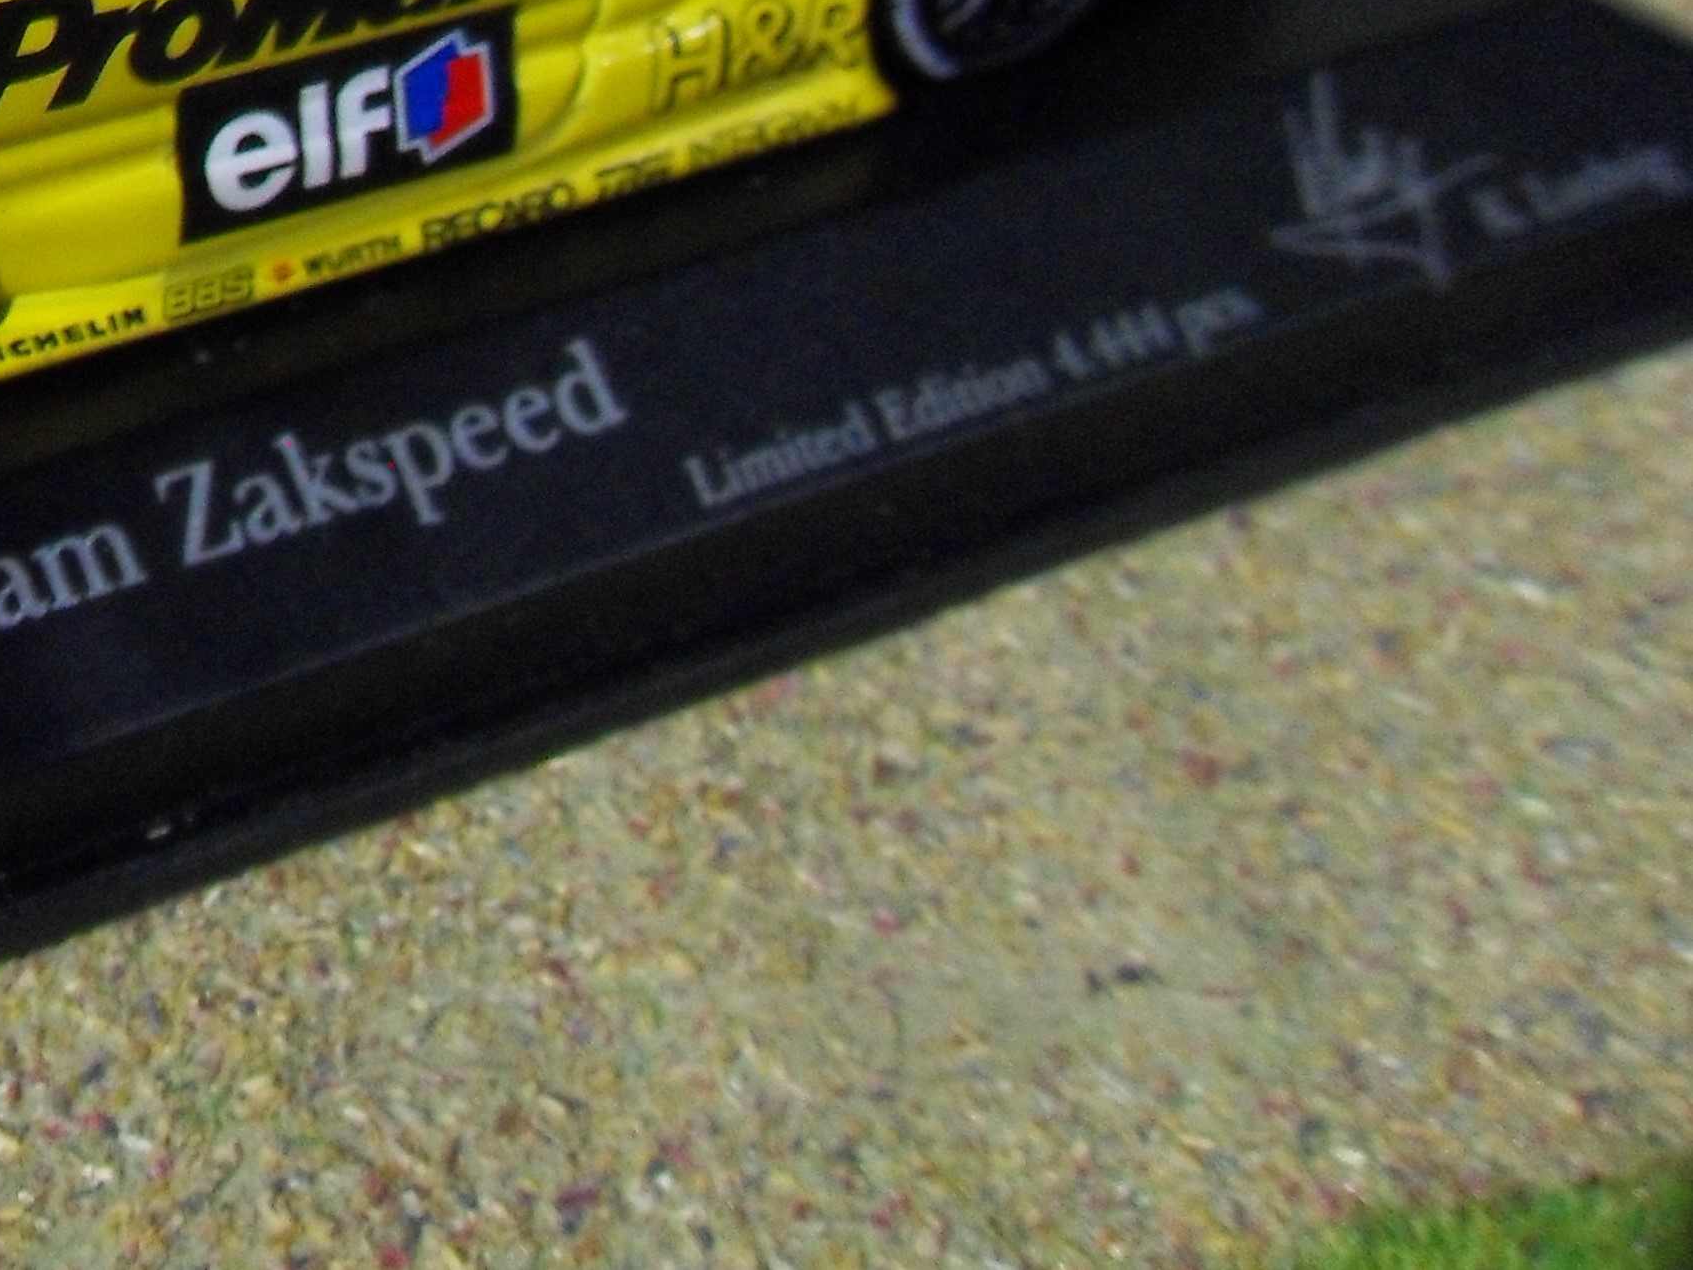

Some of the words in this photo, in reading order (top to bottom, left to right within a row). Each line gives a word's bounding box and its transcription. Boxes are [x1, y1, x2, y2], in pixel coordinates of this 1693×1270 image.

[205, 64, 397, 213] elf
[153, 338, 630, 568] Zakspeed
[681, 398, 879, 509] Limited
[873, 355, 1055, 440] Edition
